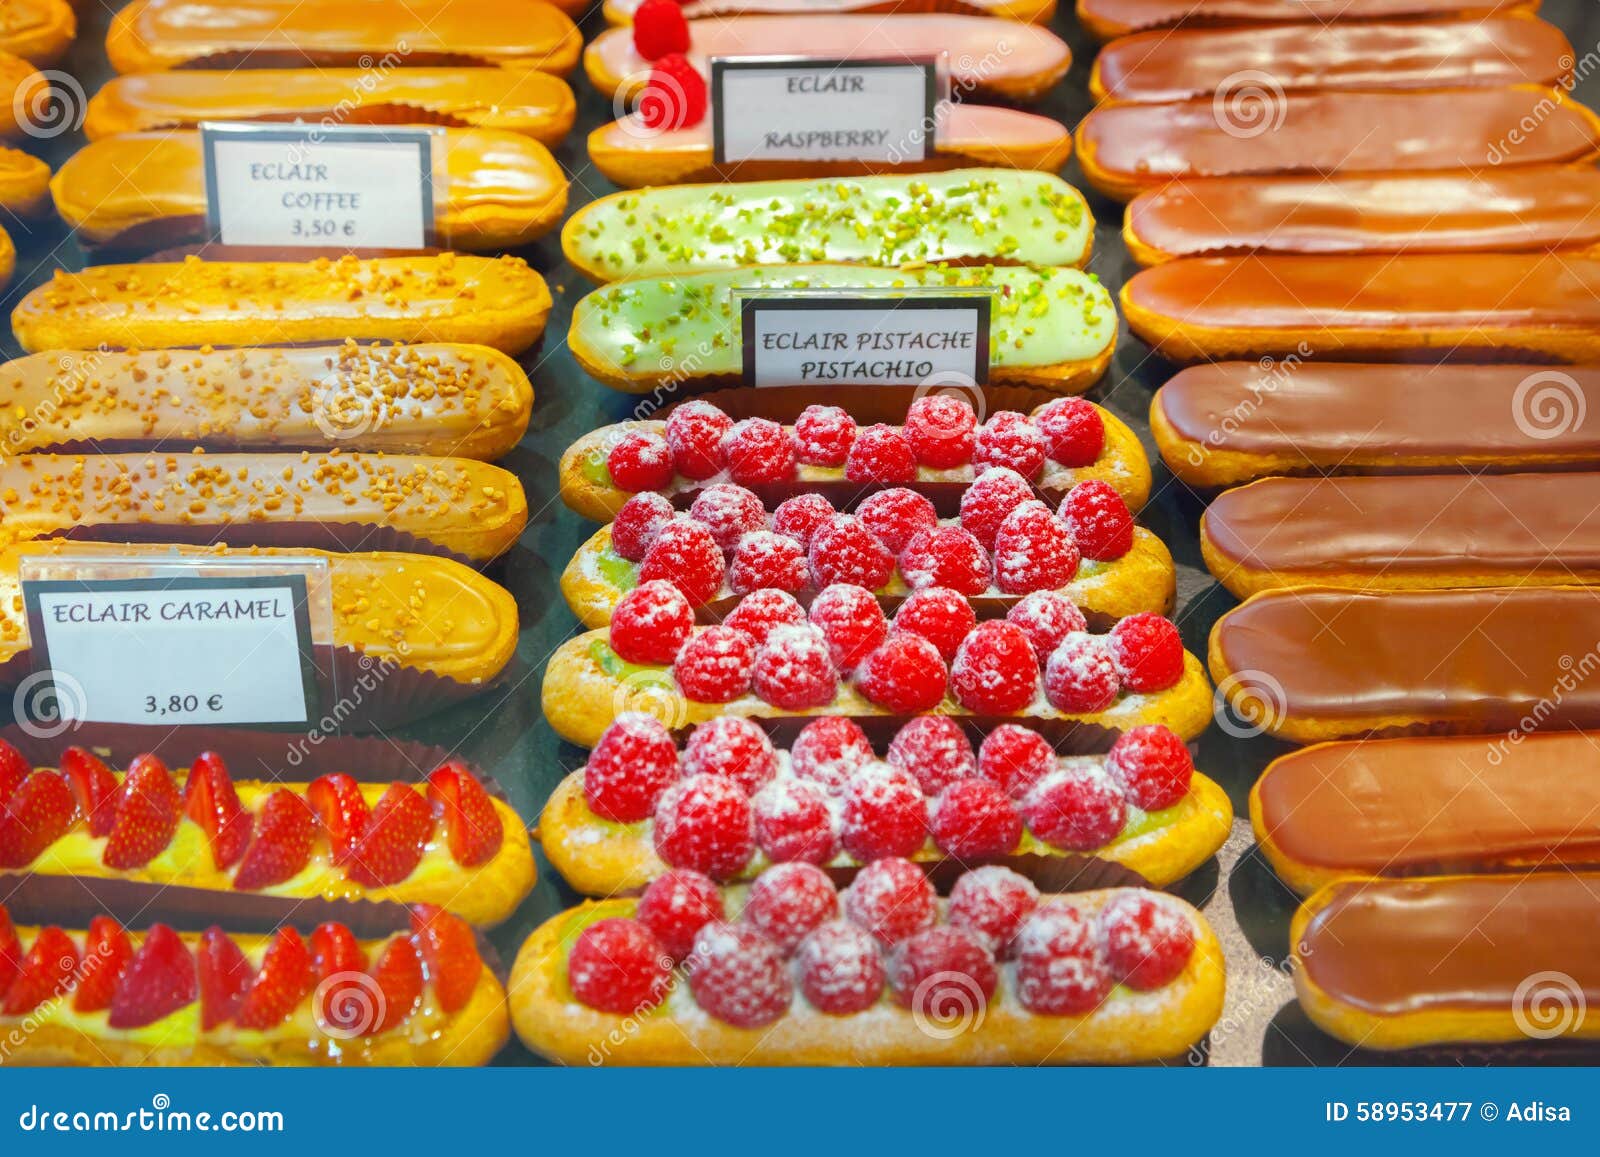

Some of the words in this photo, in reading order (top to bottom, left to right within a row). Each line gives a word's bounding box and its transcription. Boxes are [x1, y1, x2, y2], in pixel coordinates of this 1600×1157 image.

[787, 75, 865, 93] ECLAIR
[764, 129, 889, 149] RASPBERRY
[251, 163, 328, 181] ECLAIR
[282, 191, 360, 211] COFFEE
[291, 219, 336, 237] 3,50
[343, 220, 356, 235] €
[762, 332, 848, 350] ECLAIR
[857, 331, 973, 350] PISTACHE
[801, 359, 933, 380] PISTACHIO
[53, 603, 151, 623] ECLAIR
[160, 599, 286, 621] CARAMEL
[144, 695, 199, 715] 3,80
[207, 694, 224, 712] €
